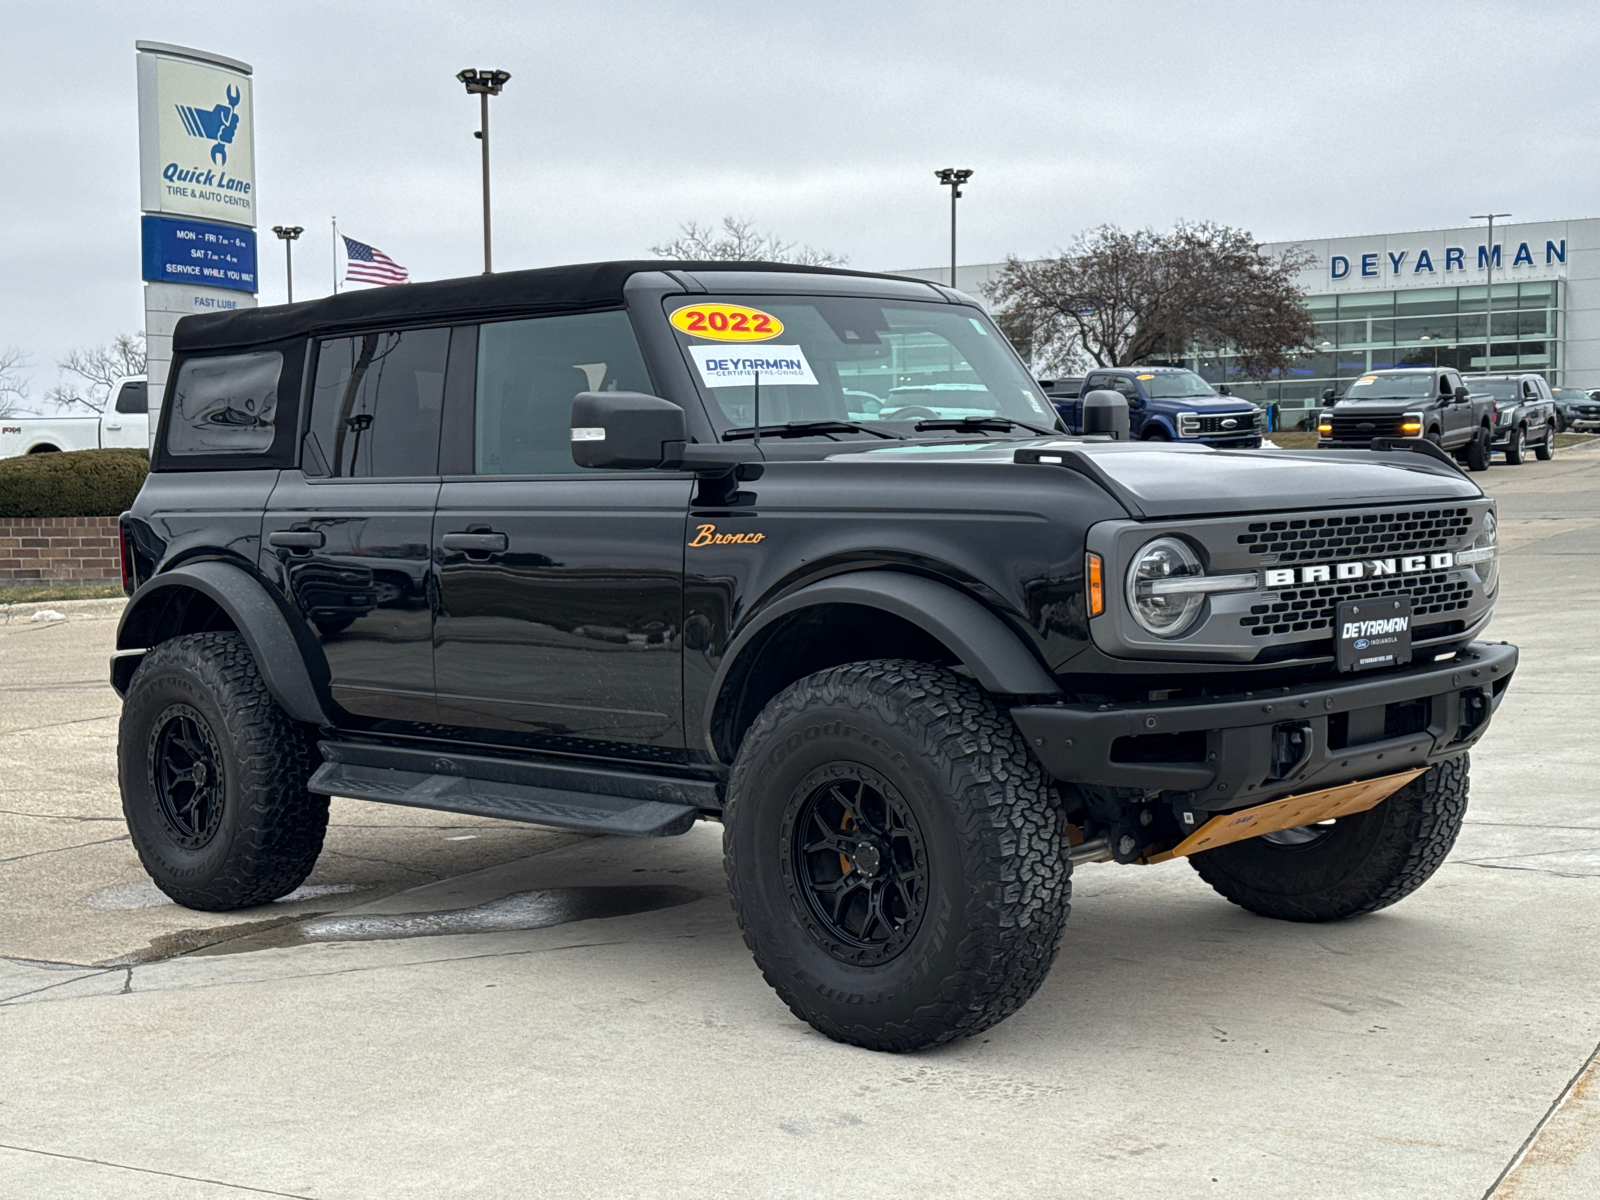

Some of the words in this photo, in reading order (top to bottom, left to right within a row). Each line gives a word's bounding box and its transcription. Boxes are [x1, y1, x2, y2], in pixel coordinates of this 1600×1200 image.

[162, 162, 217, 187] Quick
[216, 171, 251, 194] Lane
[166, 185, 189, 197] TIRE
[190, 188, 197, 199] &
[198, 190, 222, 203] AUTO
[223, 194, 251, 209] CENTER
[176, 229, 196, 240] MON
[204, 233, 217, 243] FRI
[190, 248, 205, 259] SAT
[1330, 239, 1567, 280] DEYARMAN
[165, 263, 201, 275] SERVICE
[202, 266, 225, 278] WHILE
[226, 269, 240, 281] YOU
[241, 272, 254, 283] WAIT
[194, 296, 216, 308] FAST
[217, 299, 237, 310] LUBE
[685, 311, 774, 333] 2022
[705, 358, 802, 371] DEYARMAN
[716, 369, 756, 377] CERTIFIED
[2, 426, 22, 435] FX4
[687, 523, 766, 547] Bronco
[1265, 552, 1454, 588] BRONCO
[1342, 616, 1409, 639] DEYARMAN
[1370, 636, 1398, 646] INDIANOLA
